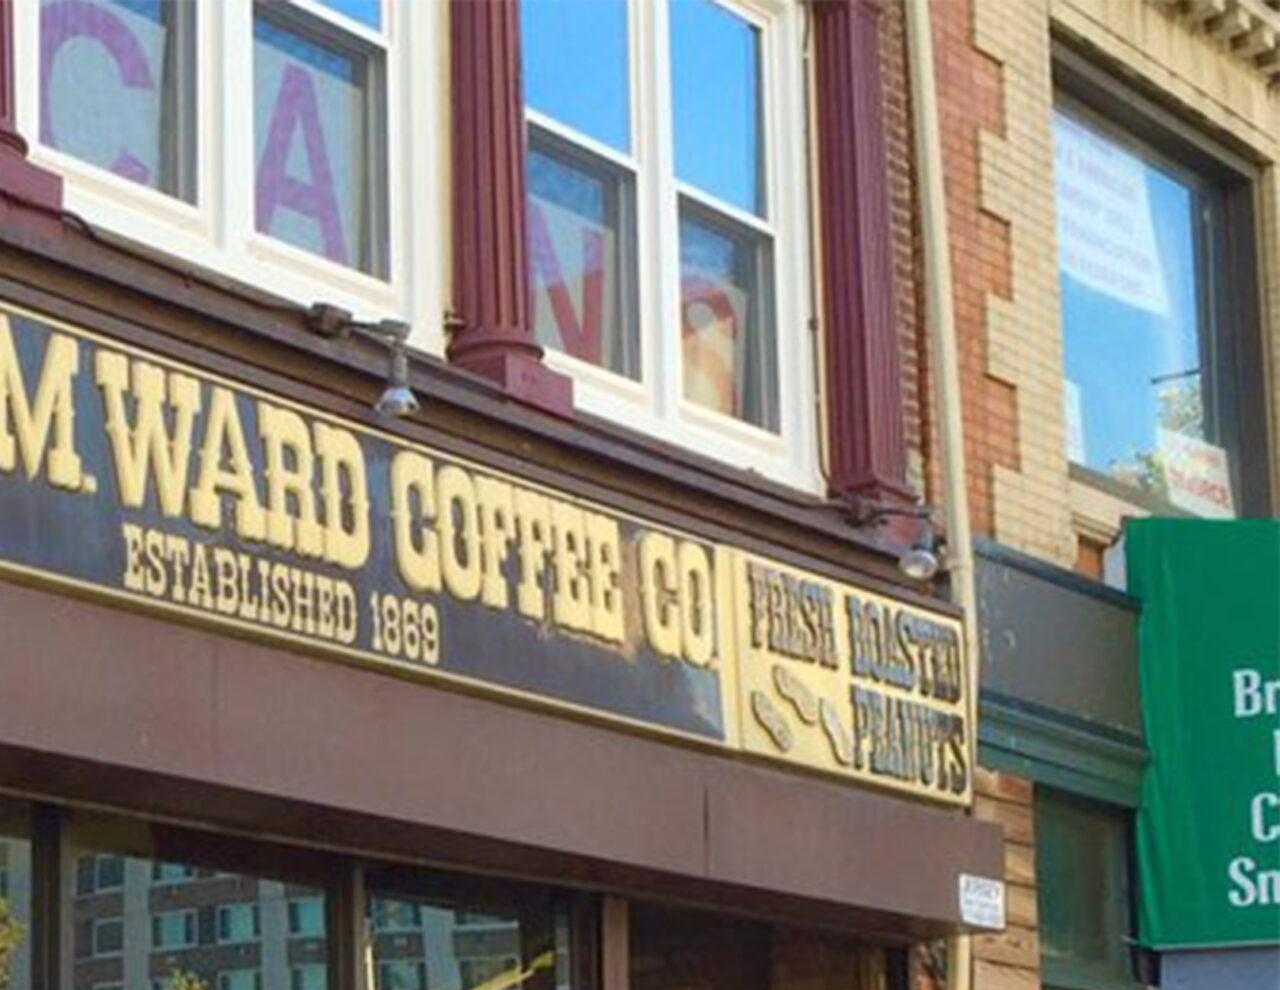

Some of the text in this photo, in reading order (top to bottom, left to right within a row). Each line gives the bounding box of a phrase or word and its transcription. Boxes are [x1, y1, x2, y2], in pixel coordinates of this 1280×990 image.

[96, 350, 371, 568] WARD
[390, 449, 623, 643] COFFEE
[123, 523, 439, 665] ESTABLISHED 1869
[746, 560, 962, 704] FRESH ROASTED
[850, 684, 967, 795] PEANUTS
